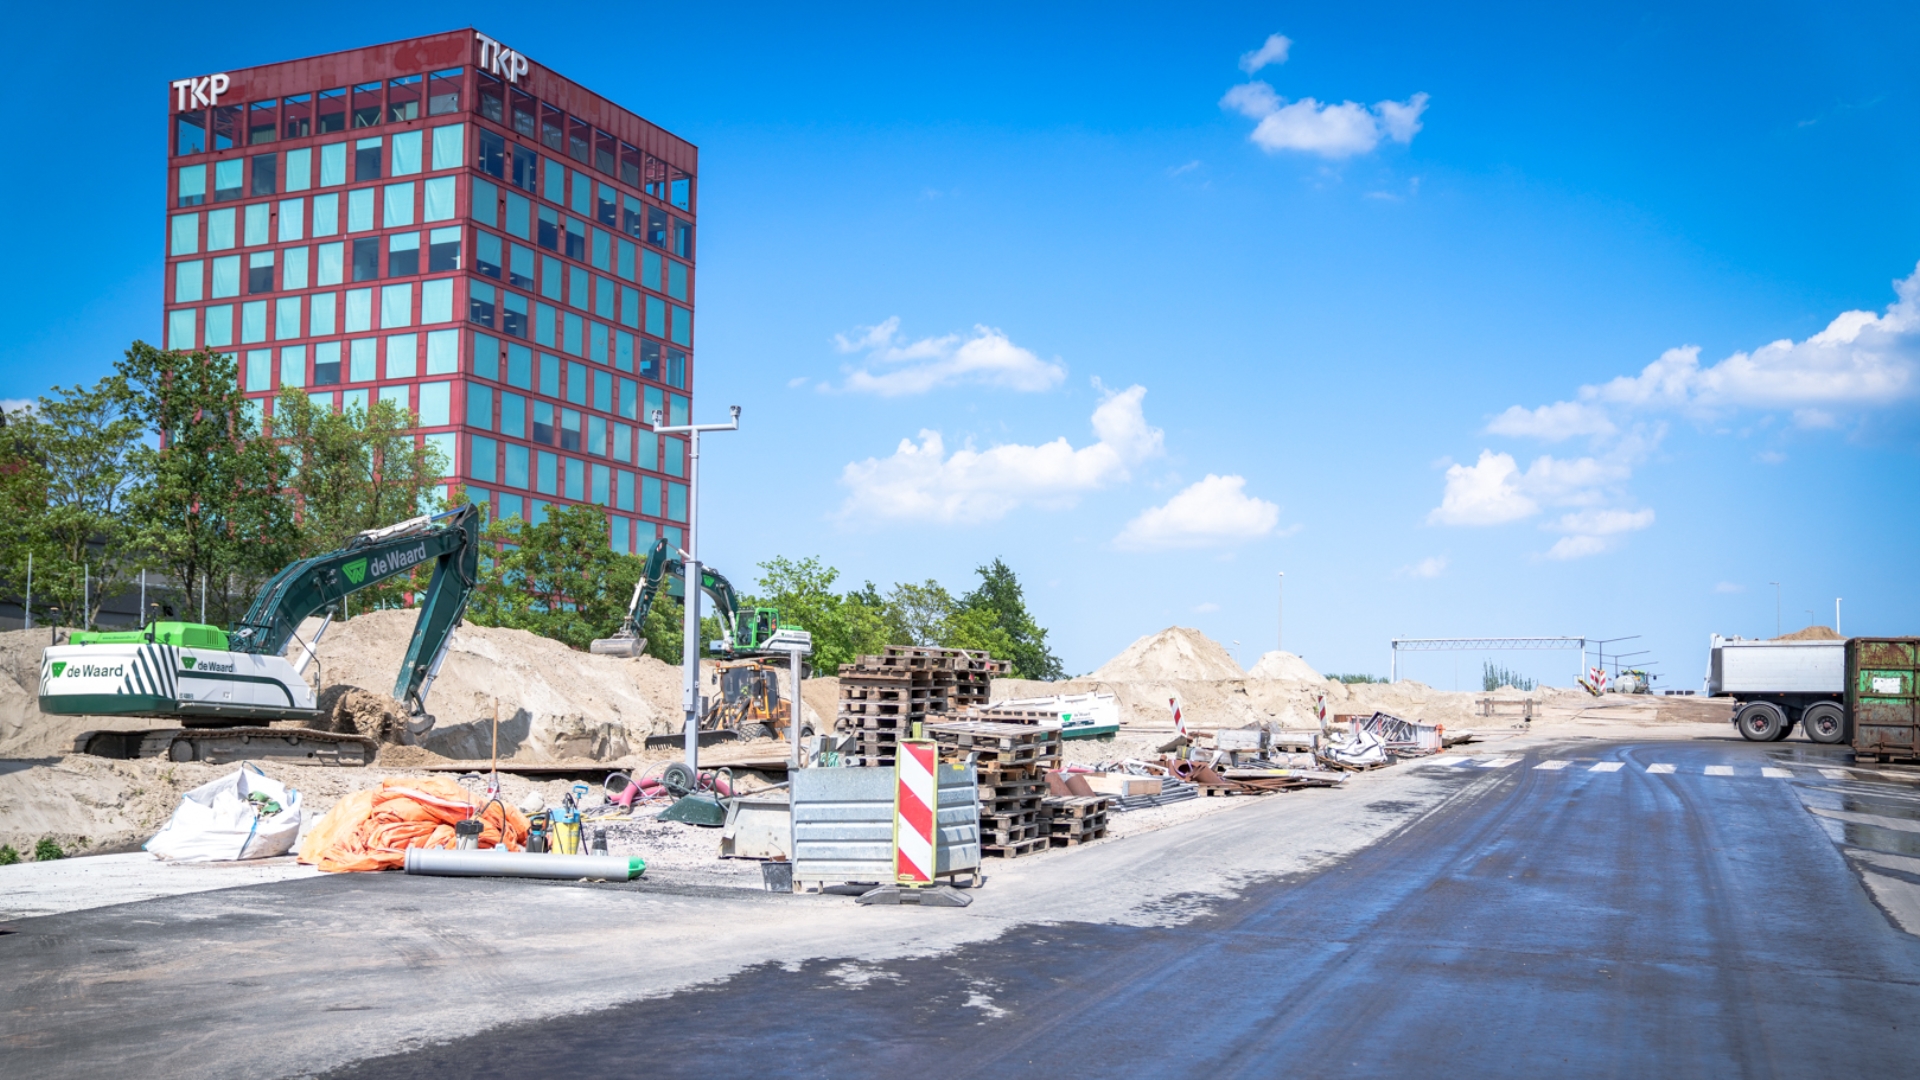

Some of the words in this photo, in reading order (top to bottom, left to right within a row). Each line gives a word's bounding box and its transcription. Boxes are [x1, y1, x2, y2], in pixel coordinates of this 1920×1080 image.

[476, 32, 528, 83] TKP
[173, 73, 230, 111] TKP
[370, 557, 388, 577] de
[386, 541, 427, 571] Waard
[67, 664, 81, 678] de
[82, 664, 123, 678] Waard
[197, 660, 208, 671] de
[208, 661, 234, 673] Waard
